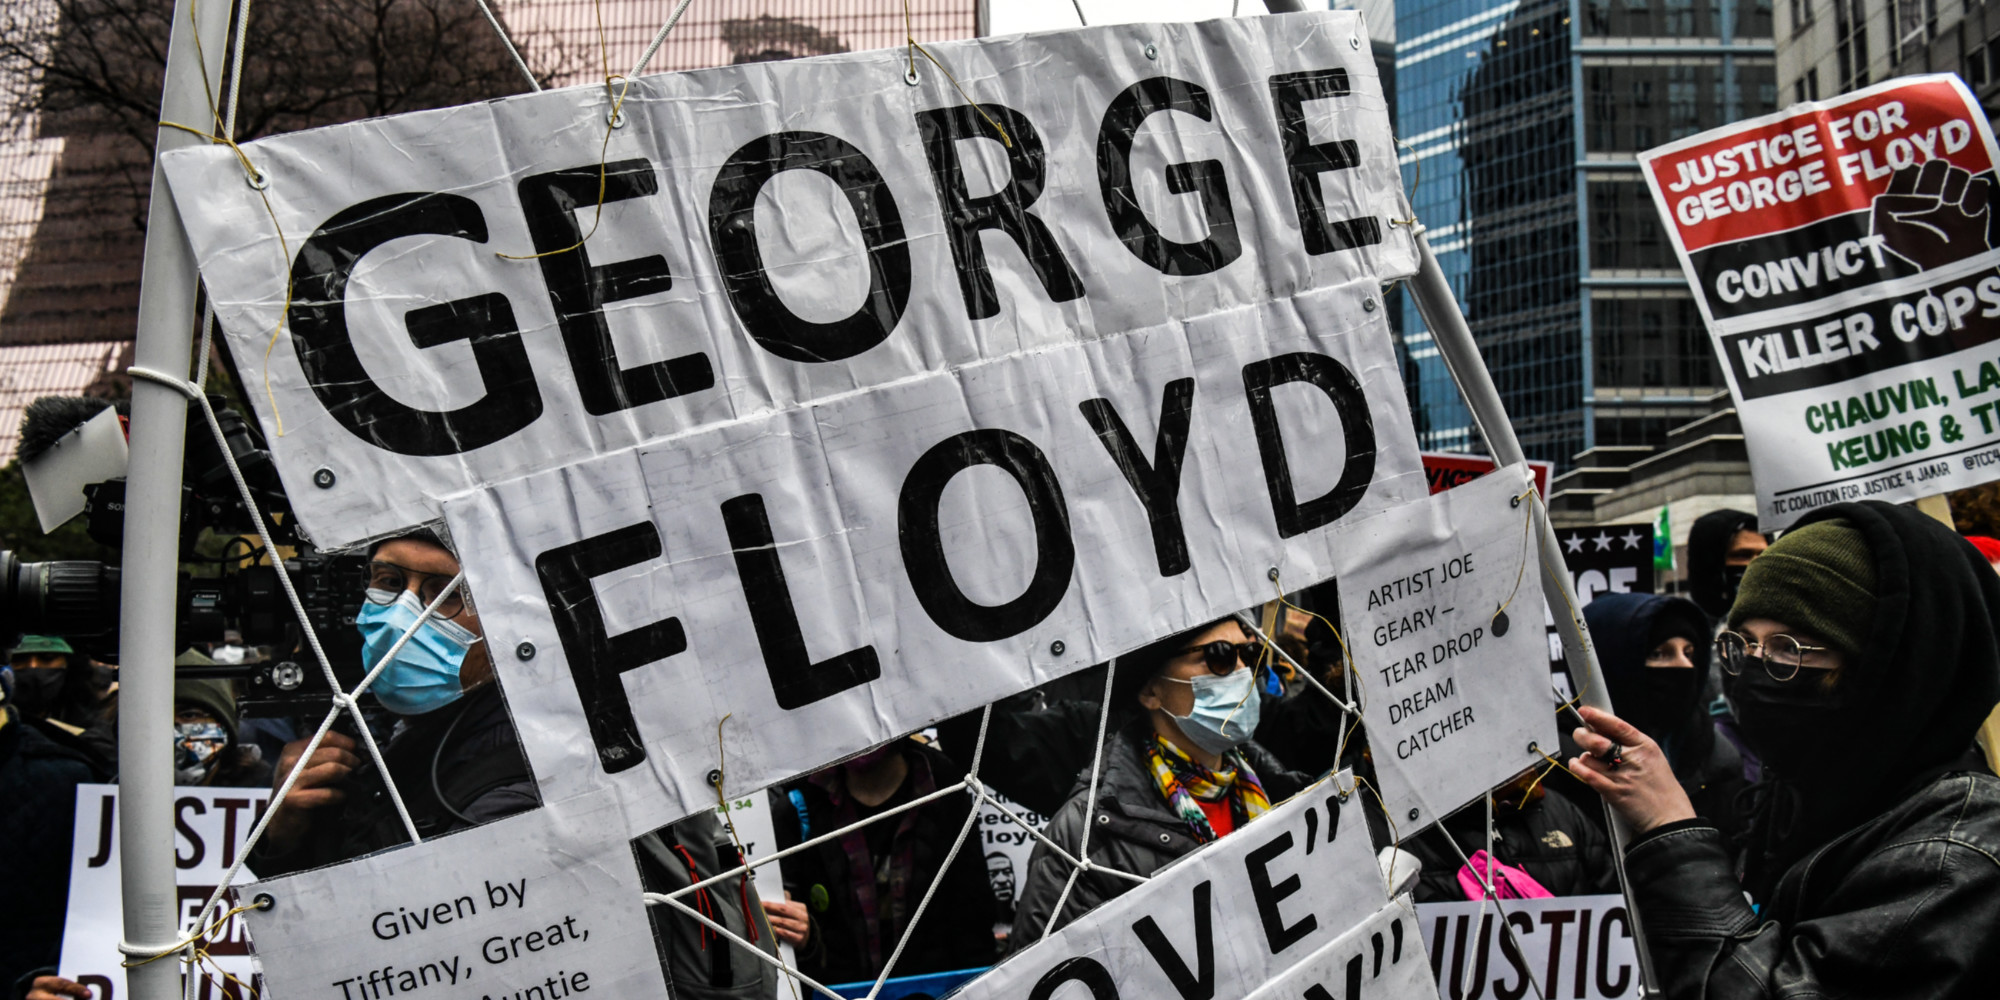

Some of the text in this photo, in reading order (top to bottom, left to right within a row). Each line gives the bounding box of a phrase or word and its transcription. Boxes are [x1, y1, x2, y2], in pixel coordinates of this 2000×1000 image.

[1669, 101, 1908, 192] JUSTICE FOR
[1676, 119, 1971, 226] GEORGE FLOYD
[288, 66, 1382, 458] GEORGE
[1716, 234, 1886, 303] CONVICT
[1738, 276, 2000, 378] KILLER COPS
[1805, 357, 2000, 434] CHAUVIN, LA
[1827, 420, 1931, 471] KEUNG
[1939, 414, 1964, 443] &
[1424, 467, 1484, 488] VIC
[1788, 488, 1840, 511] COALITION
[1841, 484, 1861, 499] FOR
[1864, 473, 1904, 495] JUSTICE
[535, 350, 1378, 775] FLOYD
[1368, 553, 1474, 611] ARTIST JOE
[1374, 605, 1437, 647] GEARY
[1380, 627, 1484, 687] TEAR DROP
[1389, 677, 1454, 725] DREAM
[1397, 706, 1475, 760] CATCHER
[372, 878, 526, 940] Given by
[332, 916, 589, 1000] Tiffany, Great,
[1430, 907, 1641, 1000] JUSTIC
